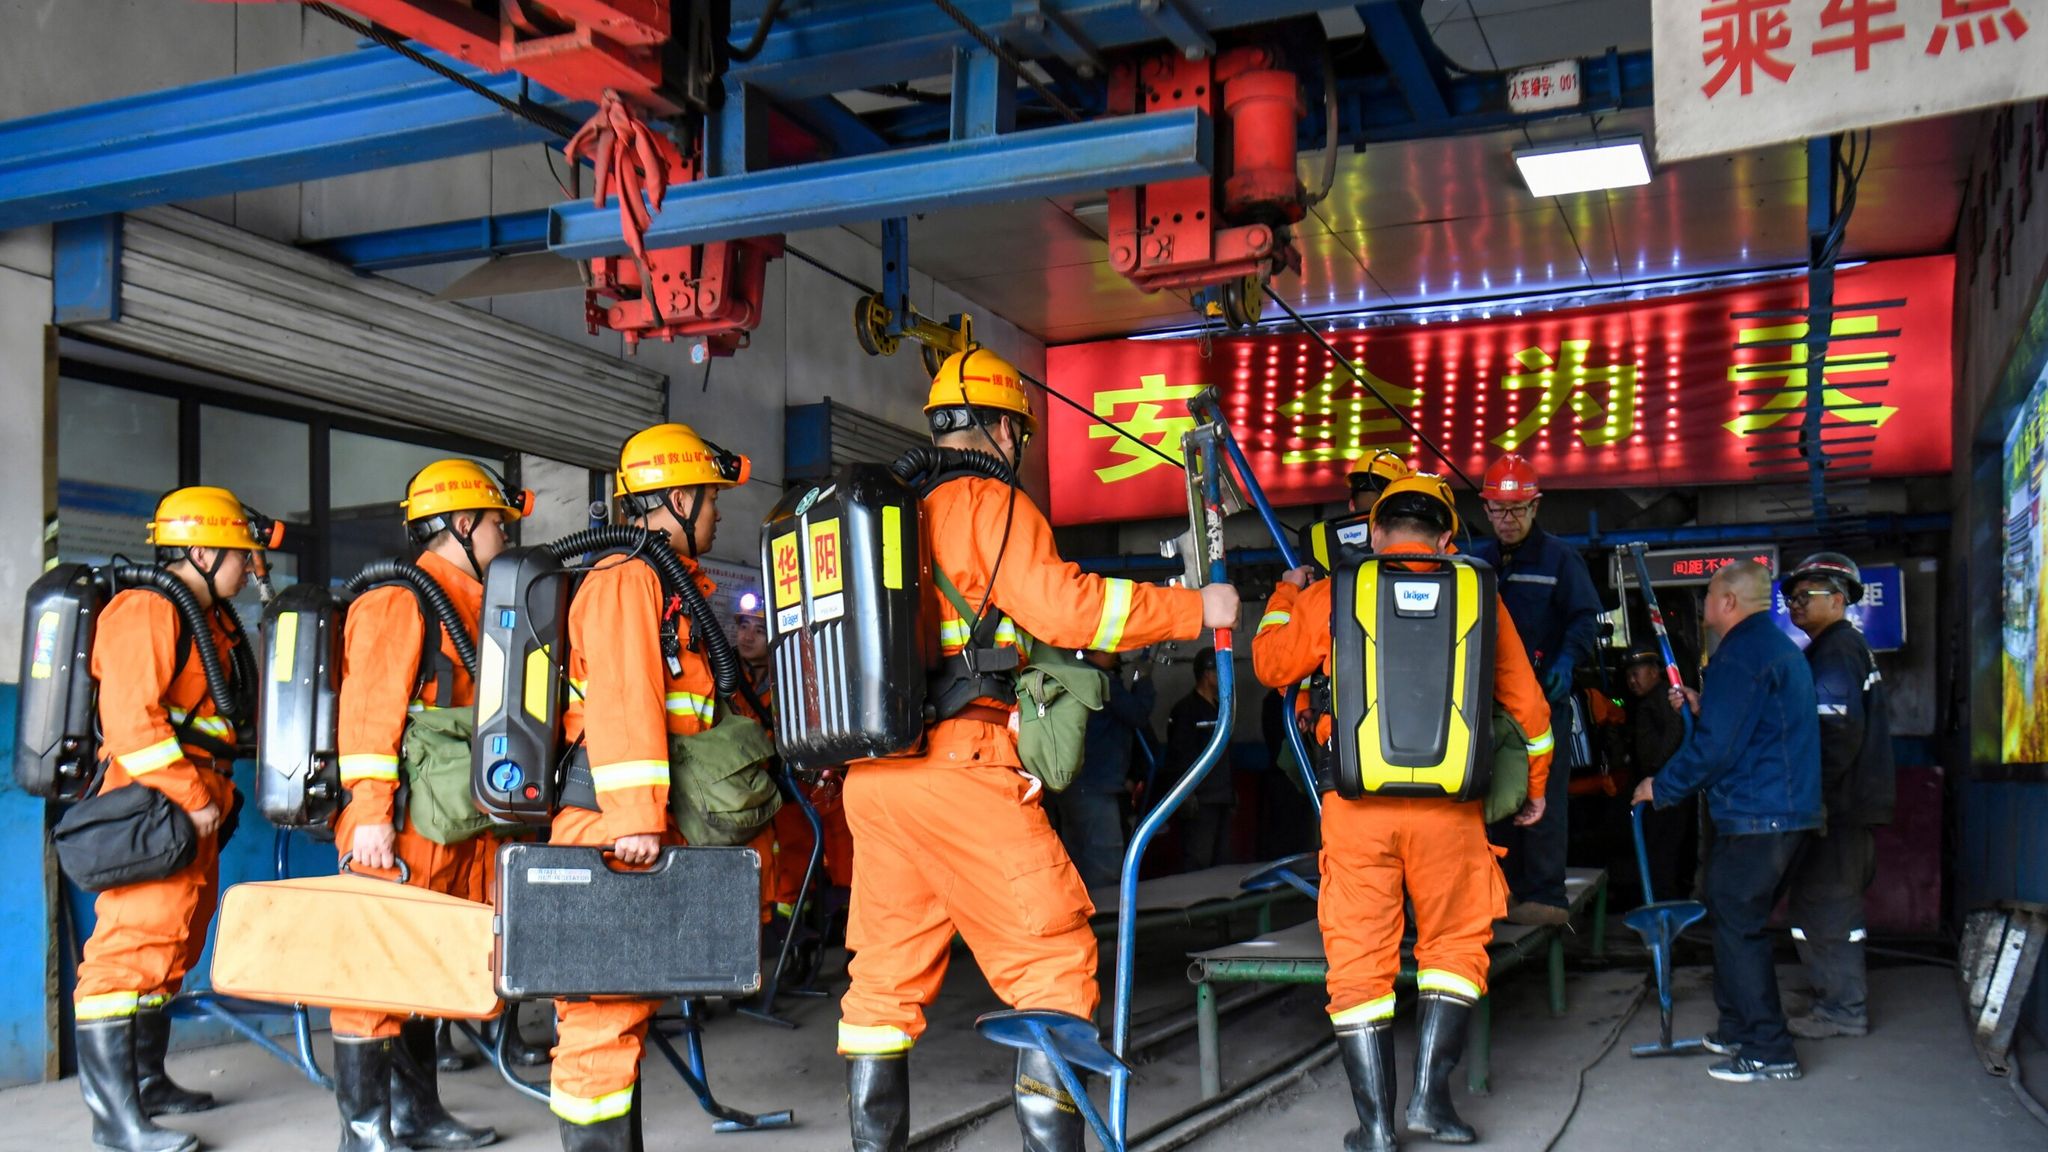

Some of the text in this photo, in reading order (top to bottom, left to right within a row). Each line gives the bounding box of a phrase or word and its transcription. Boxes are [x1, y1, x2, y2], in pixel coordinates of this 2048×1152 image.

[1560, 73, 1577, 91] 001
[1089, 315, 1899, 483] 安全为天
[1343, 531, 1362, 540] Dräger
[778, 532, 837, 595] 华阳
[1403, 590, 1430, 601] Dräger
[782, 613, 799, 627] Dräger
